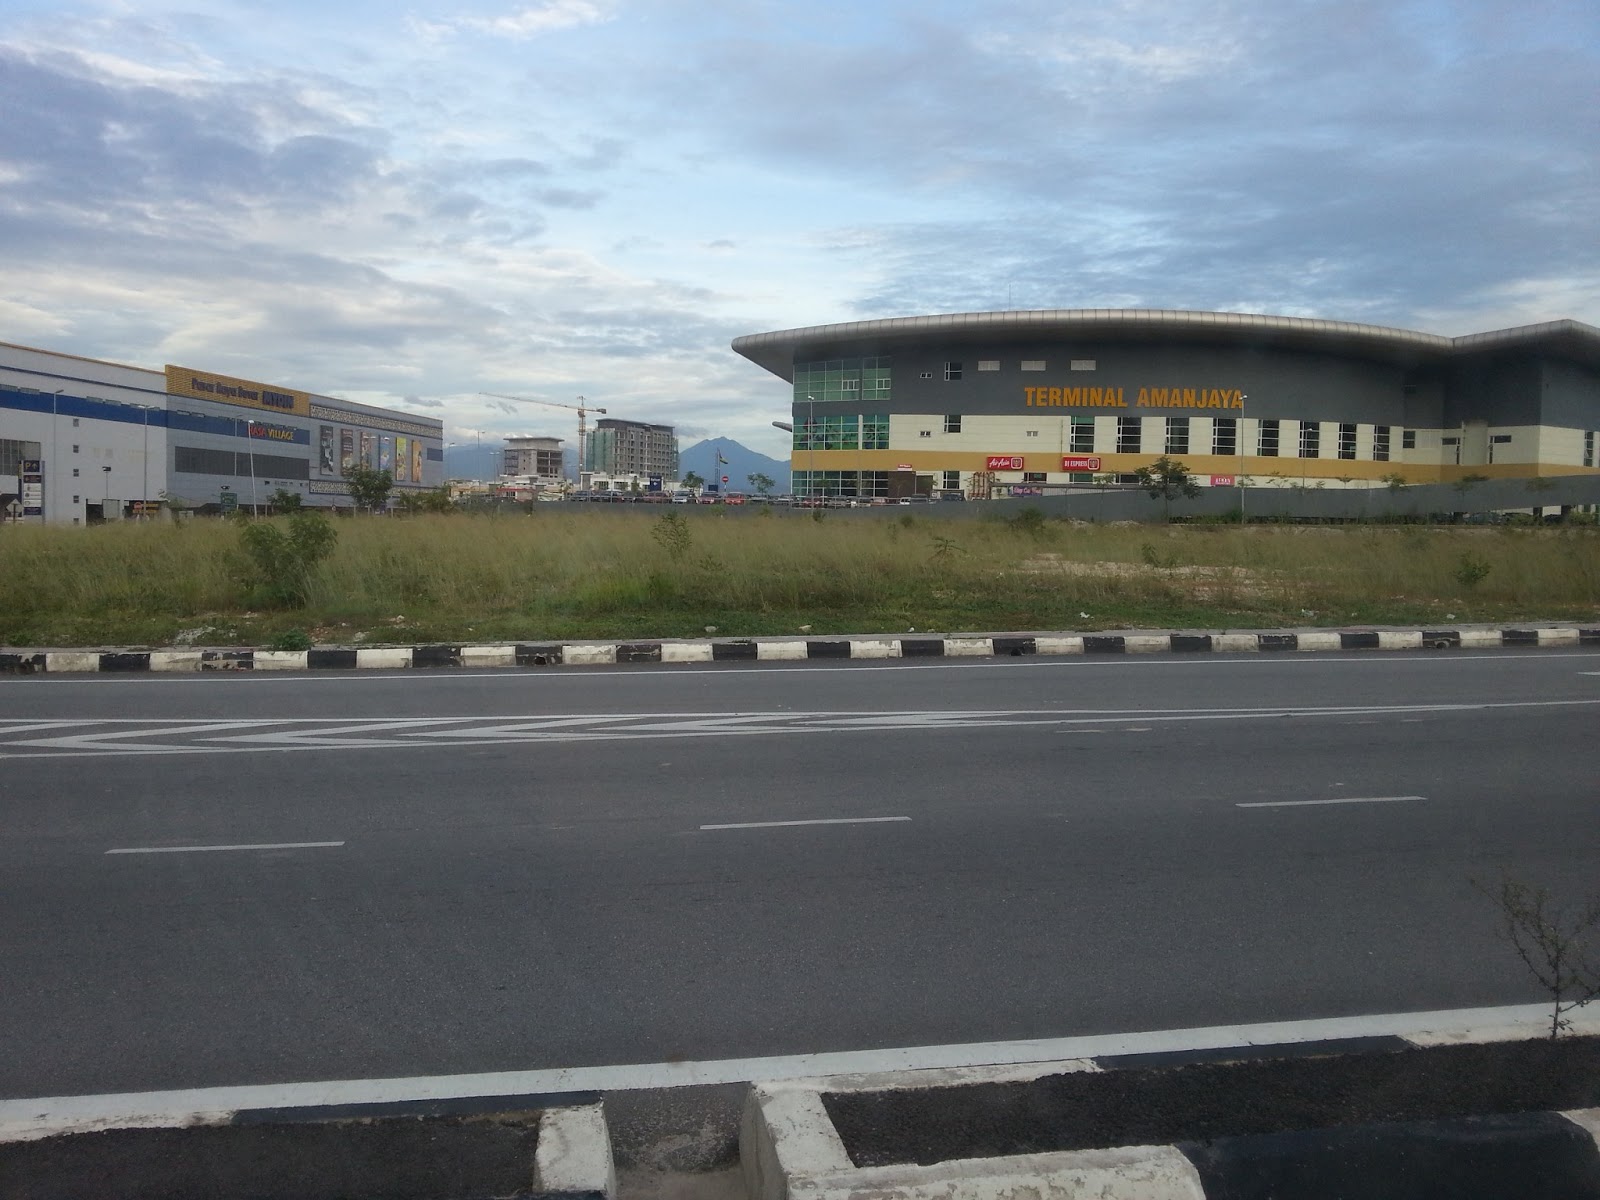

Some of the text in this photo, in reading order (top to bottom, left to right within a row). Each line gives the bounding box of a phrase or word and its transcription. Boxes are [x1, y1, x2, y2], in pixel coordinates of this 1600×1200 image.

[1024, 387, 1243, 409] TERMINAL AMANJAYA
[267, 428, 294, 440] VILLAGE
